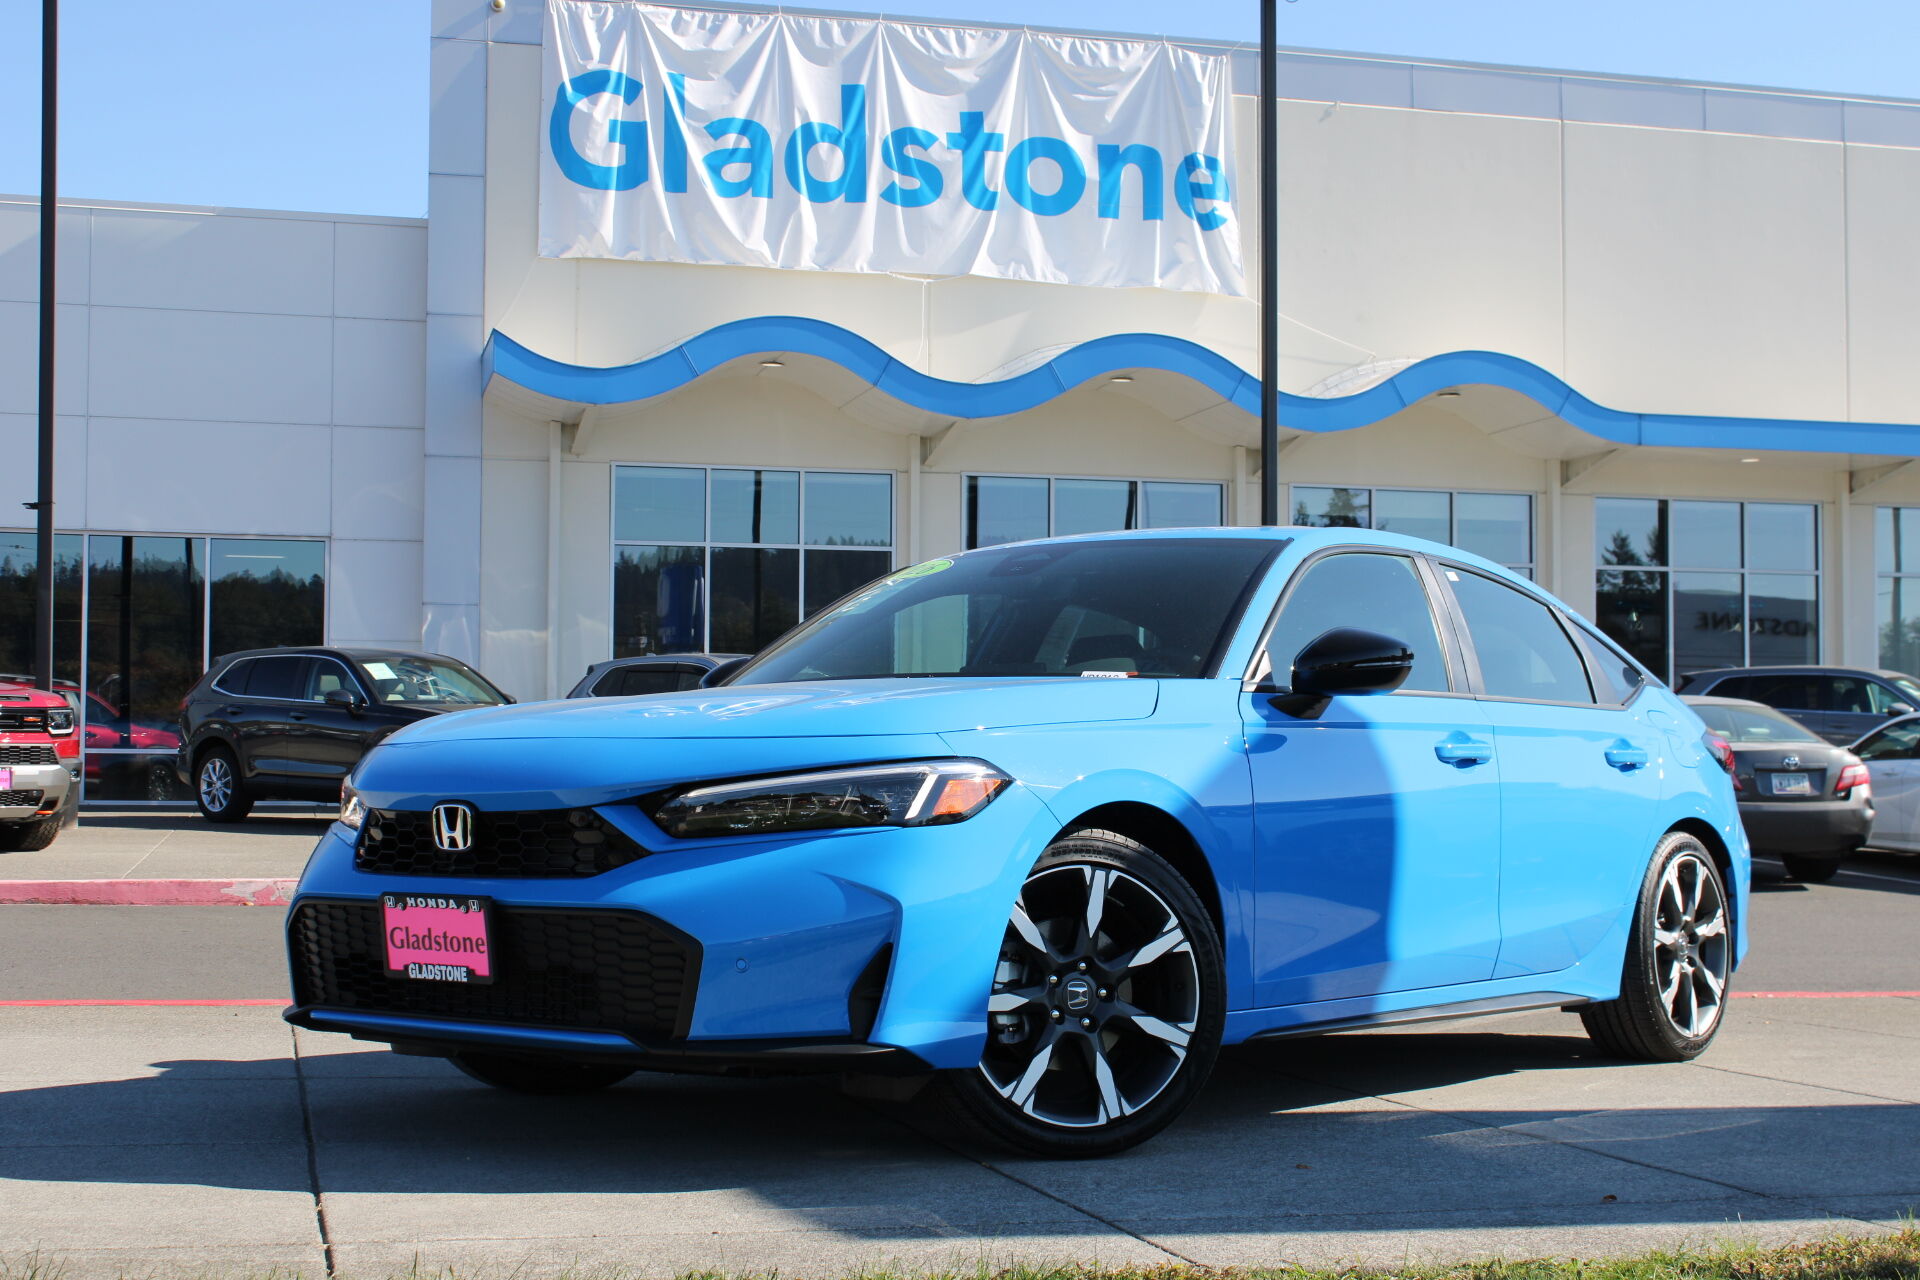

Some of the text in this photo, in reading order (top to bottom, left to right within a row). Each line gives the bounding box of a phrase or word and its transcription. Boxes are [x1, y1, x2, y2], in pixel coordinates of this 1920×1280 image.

[549, 68, 1230, 232] Gladstone
[406, 897, 458, 909] HONDA
[389, 926, 486, 954] Gladstone
[408, 963, 468, 982] GLADSTONE
